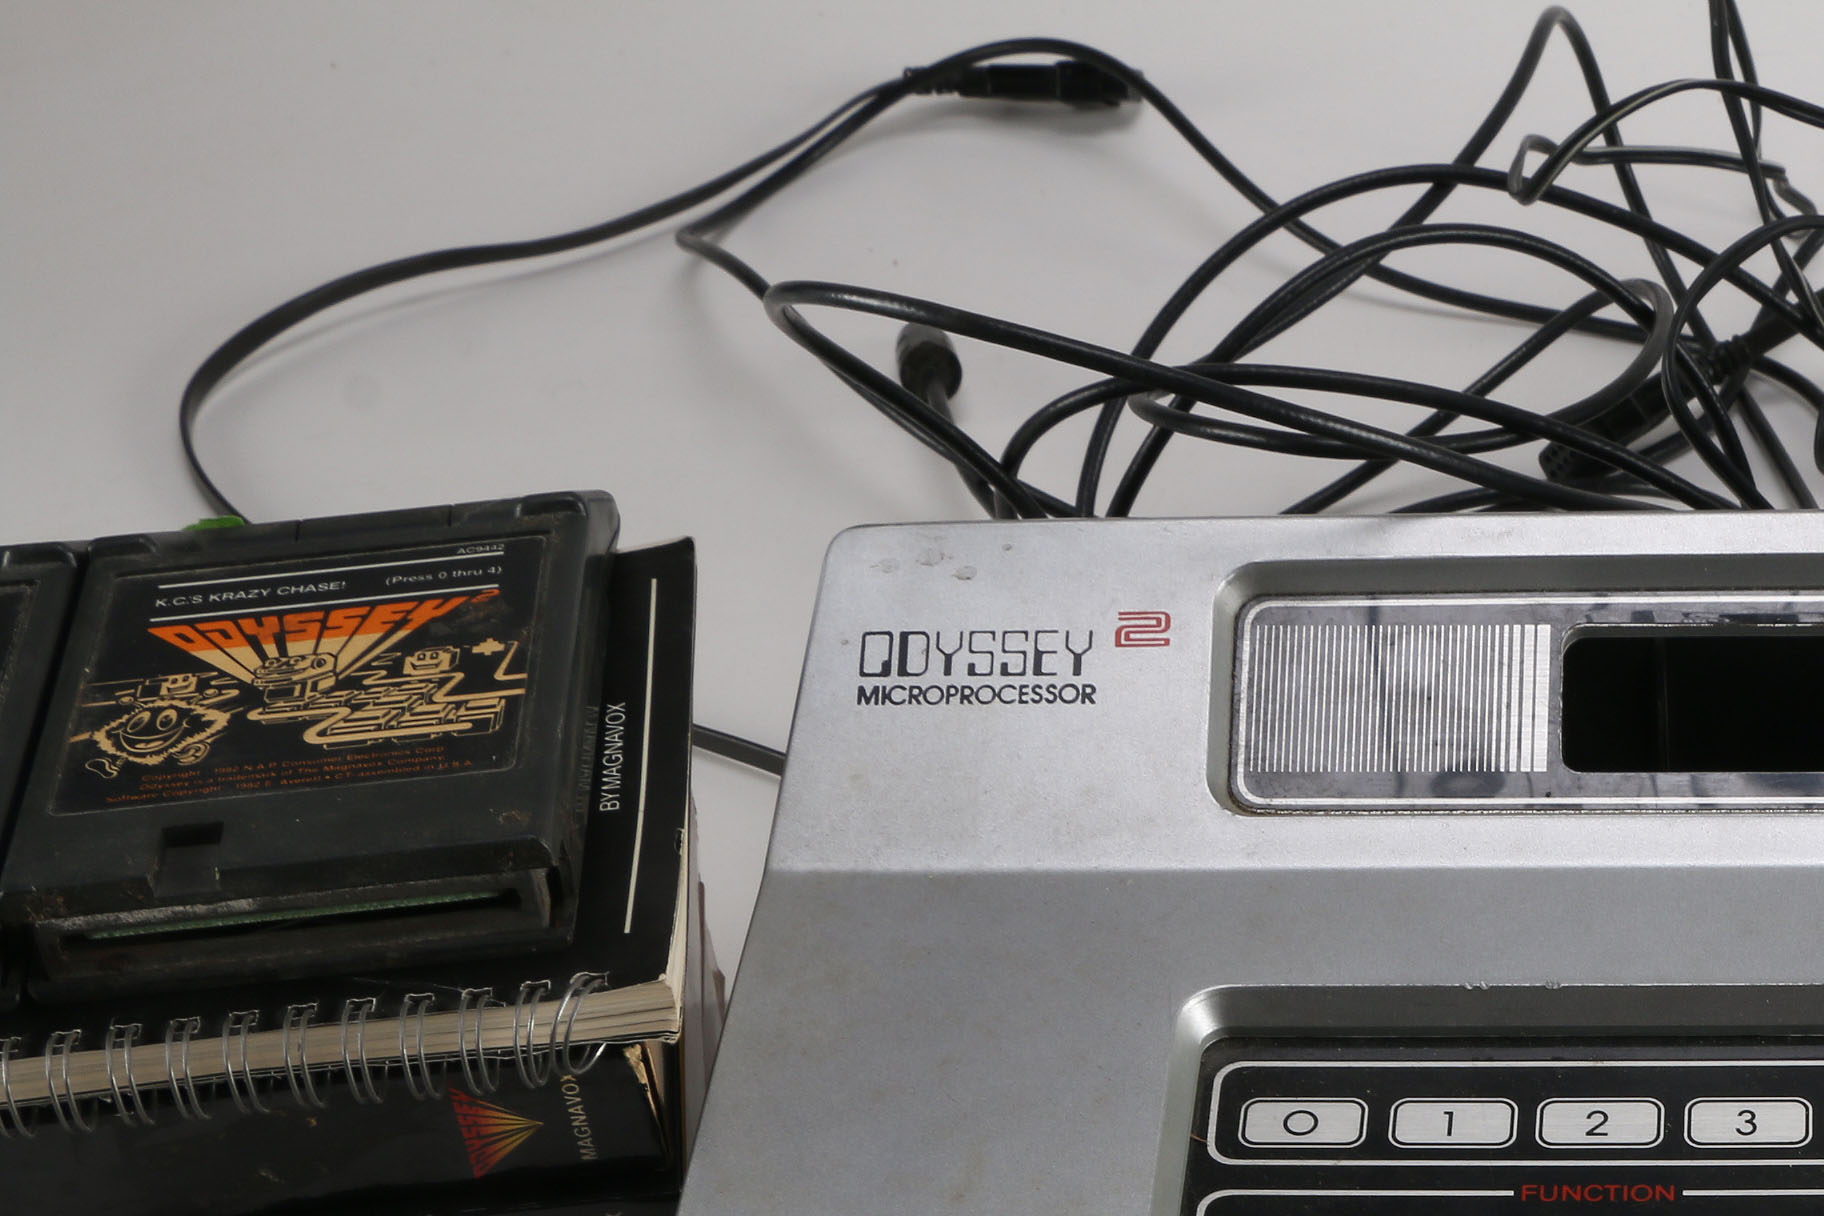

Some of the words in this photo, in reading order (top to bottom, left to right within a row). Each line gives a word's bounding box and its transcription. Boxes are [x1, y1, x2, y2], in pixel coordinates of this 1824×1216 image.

[385, 574, 434, 588] (Press
[452, 567, 483, 577] thru
[487, 565, 503, 577] 4)
[208, 587, 271, 603] KRAZY
[276, 581, 347, 596] CHASE!
[856, 682, 1097, 707] MICROPROCESSOR
[601, 702, 626, 790] MAGNAVOX
[599, 792, 620, 811] BY
[1443, 1111, 1454, 1137] 1
[1585, 1110, 1609, 1137] 2
[1735, 1109, 1758, 1136] 3
[1520, 1183, 1676, 1203] FUNCTION
